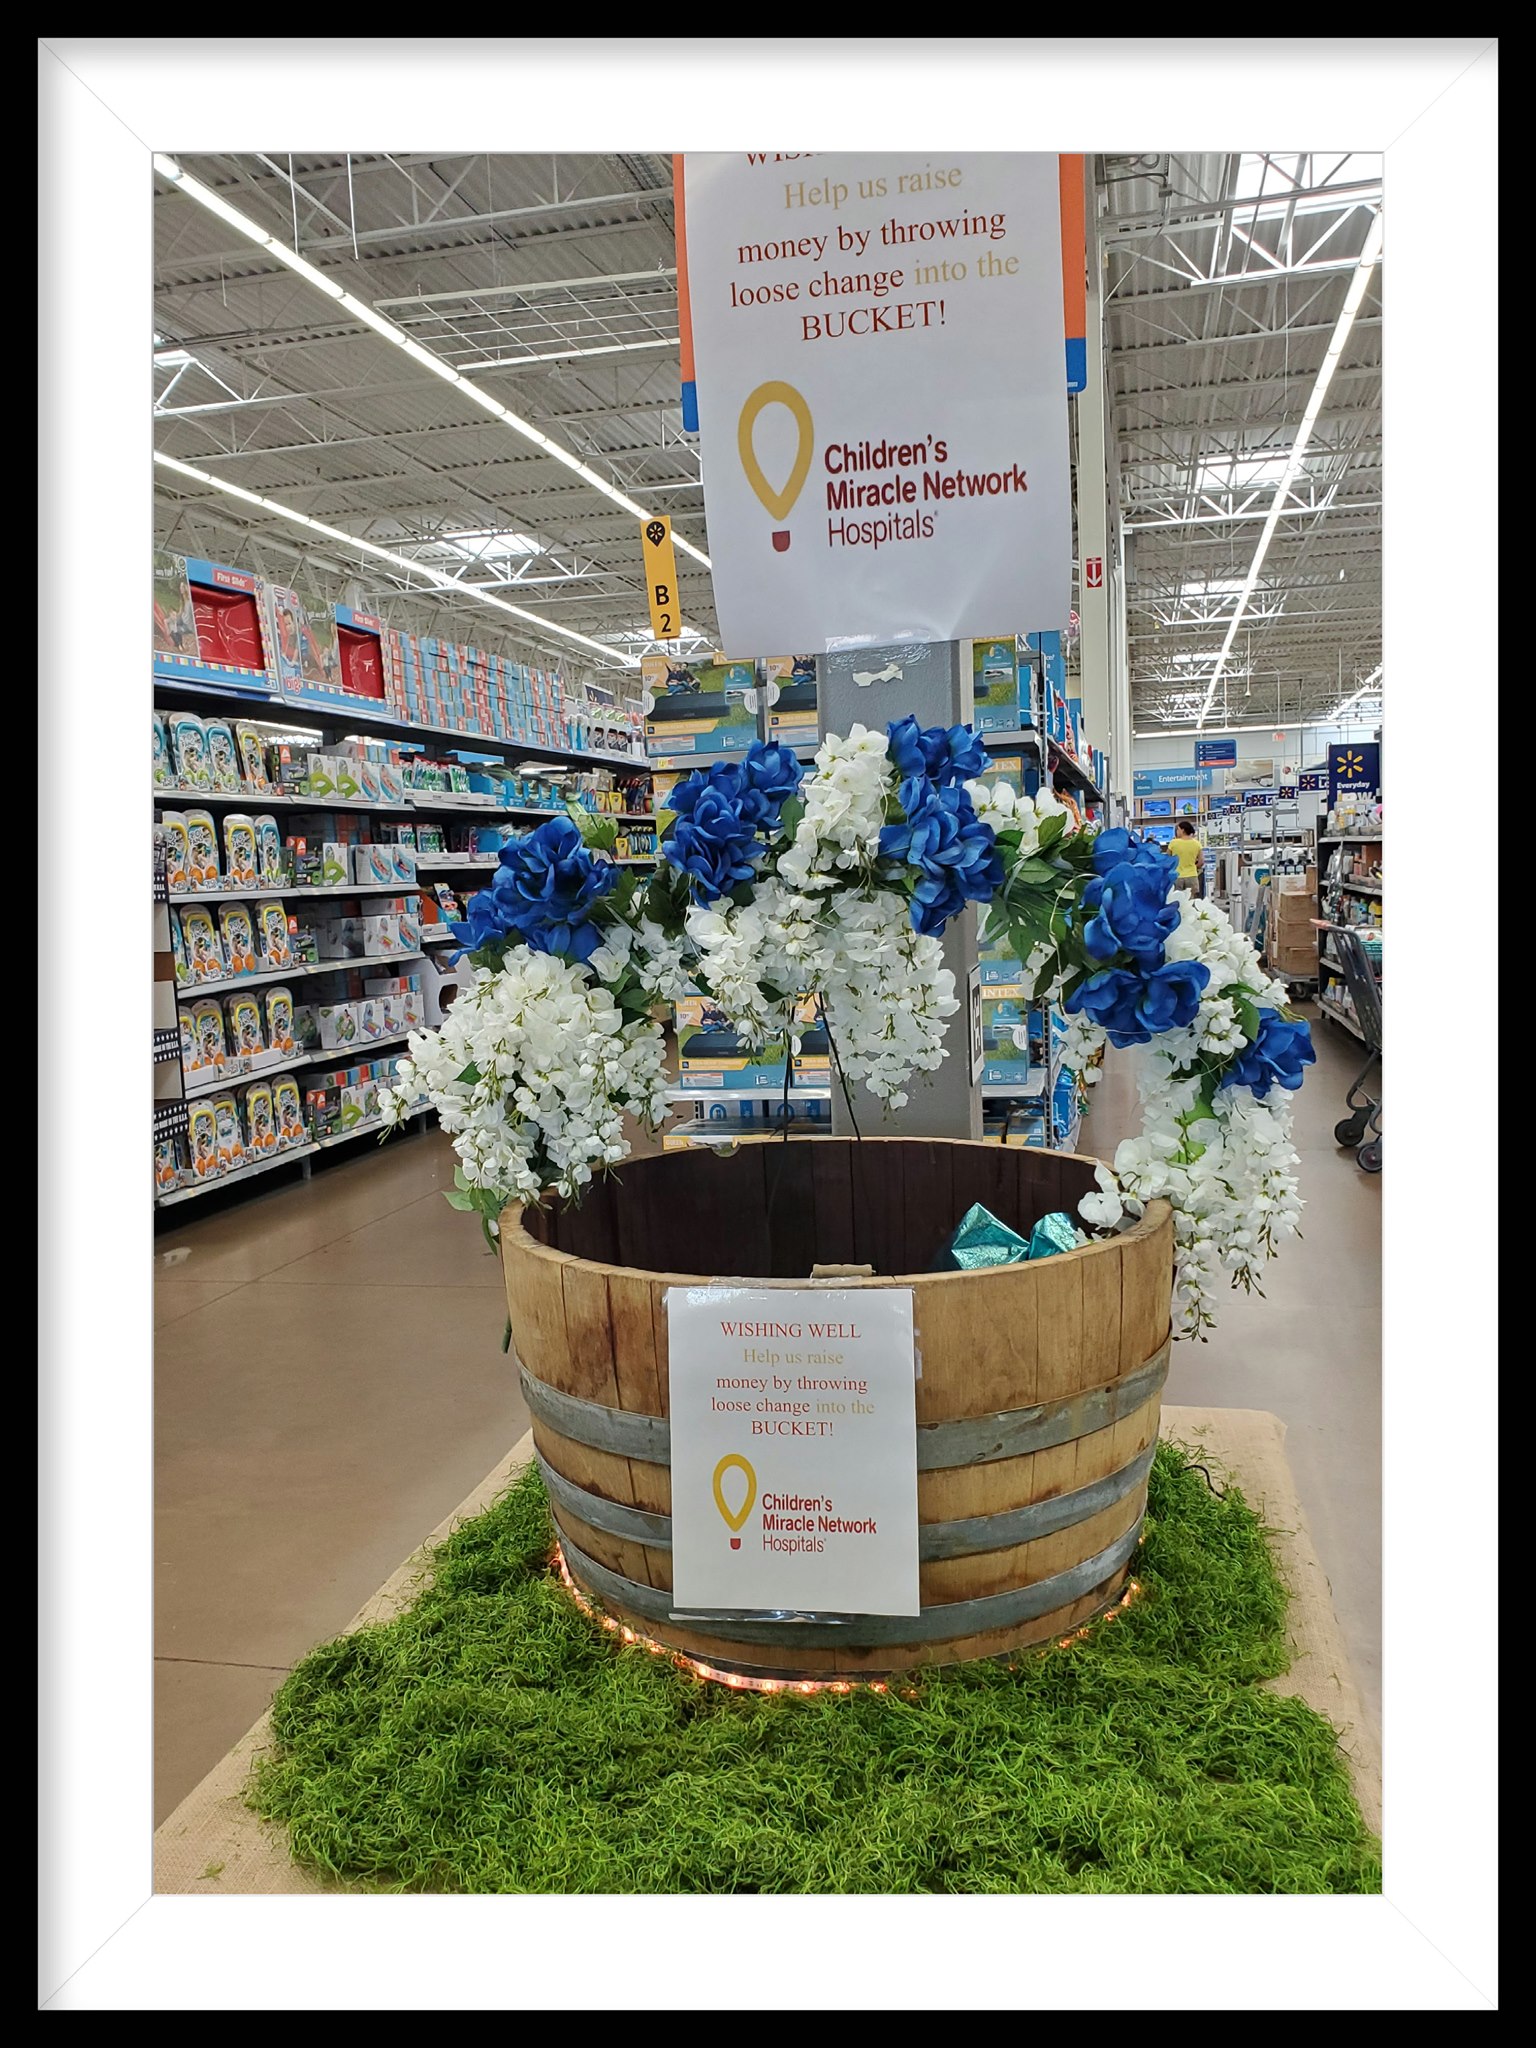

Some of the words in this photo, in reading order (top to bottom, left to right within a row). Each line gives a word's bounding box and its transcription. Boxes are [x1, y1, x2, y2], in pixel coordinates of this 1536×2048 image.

[784, 178, 849, 210] Help
[859, 175, 888, 198] us
[898, 164, 963, 194] raise
[738, 235, 828, 264] money
[838, 227, 870, 256] by
[881, 210, 1006, 245] throwing
[731, 282, 799, 307] loose
[809, 269, 904, 298] change
[914, 258, 967, 285] into
[977, 250, 1020, 278] the
[801, 300, 946, 341] BUCKET!
[824, 434, 948, 474] Children's
[826, 474, 916, 511] Miracle
[923, 463, 1028, 499] Network
[827, 510, 934, 550] Hospitals
[655, 585, 670, 606] B
[660, 613, 672, 633] 2
[1158, 773, 1208, 783] Entertainment
[1336, 781, 1371, 790] Everyday
[982, 987, 1019, 998] INTEX
[720, 1321, 802, 1338] WISHING
[808, 1323, 861, 1338] WELL
[743, 1348, 780, 1366] Help
[785, 1353, 803, 1364] us
[807, 1348, 844, 1364] raise
[716, 1378, 768, 1393] money
[773, 1375, 792, 1393] by
[797, 1376, 868, 1395] throwing
[711, 1397, 751, 1412] loose
[756, 1397, 810, 1417] change
[816, 1399, 846, 1414] into
[851, 1399, 875, 1414] the
[751, 1420, 834, 1437] BUCKET!
[762, 1493, 833, 1512] Children's
[762, 1514, 815, 1532] Miracle
[817, 1516, 877, 1534] Network
[762, 1534, 824, 1556] Hospitals
